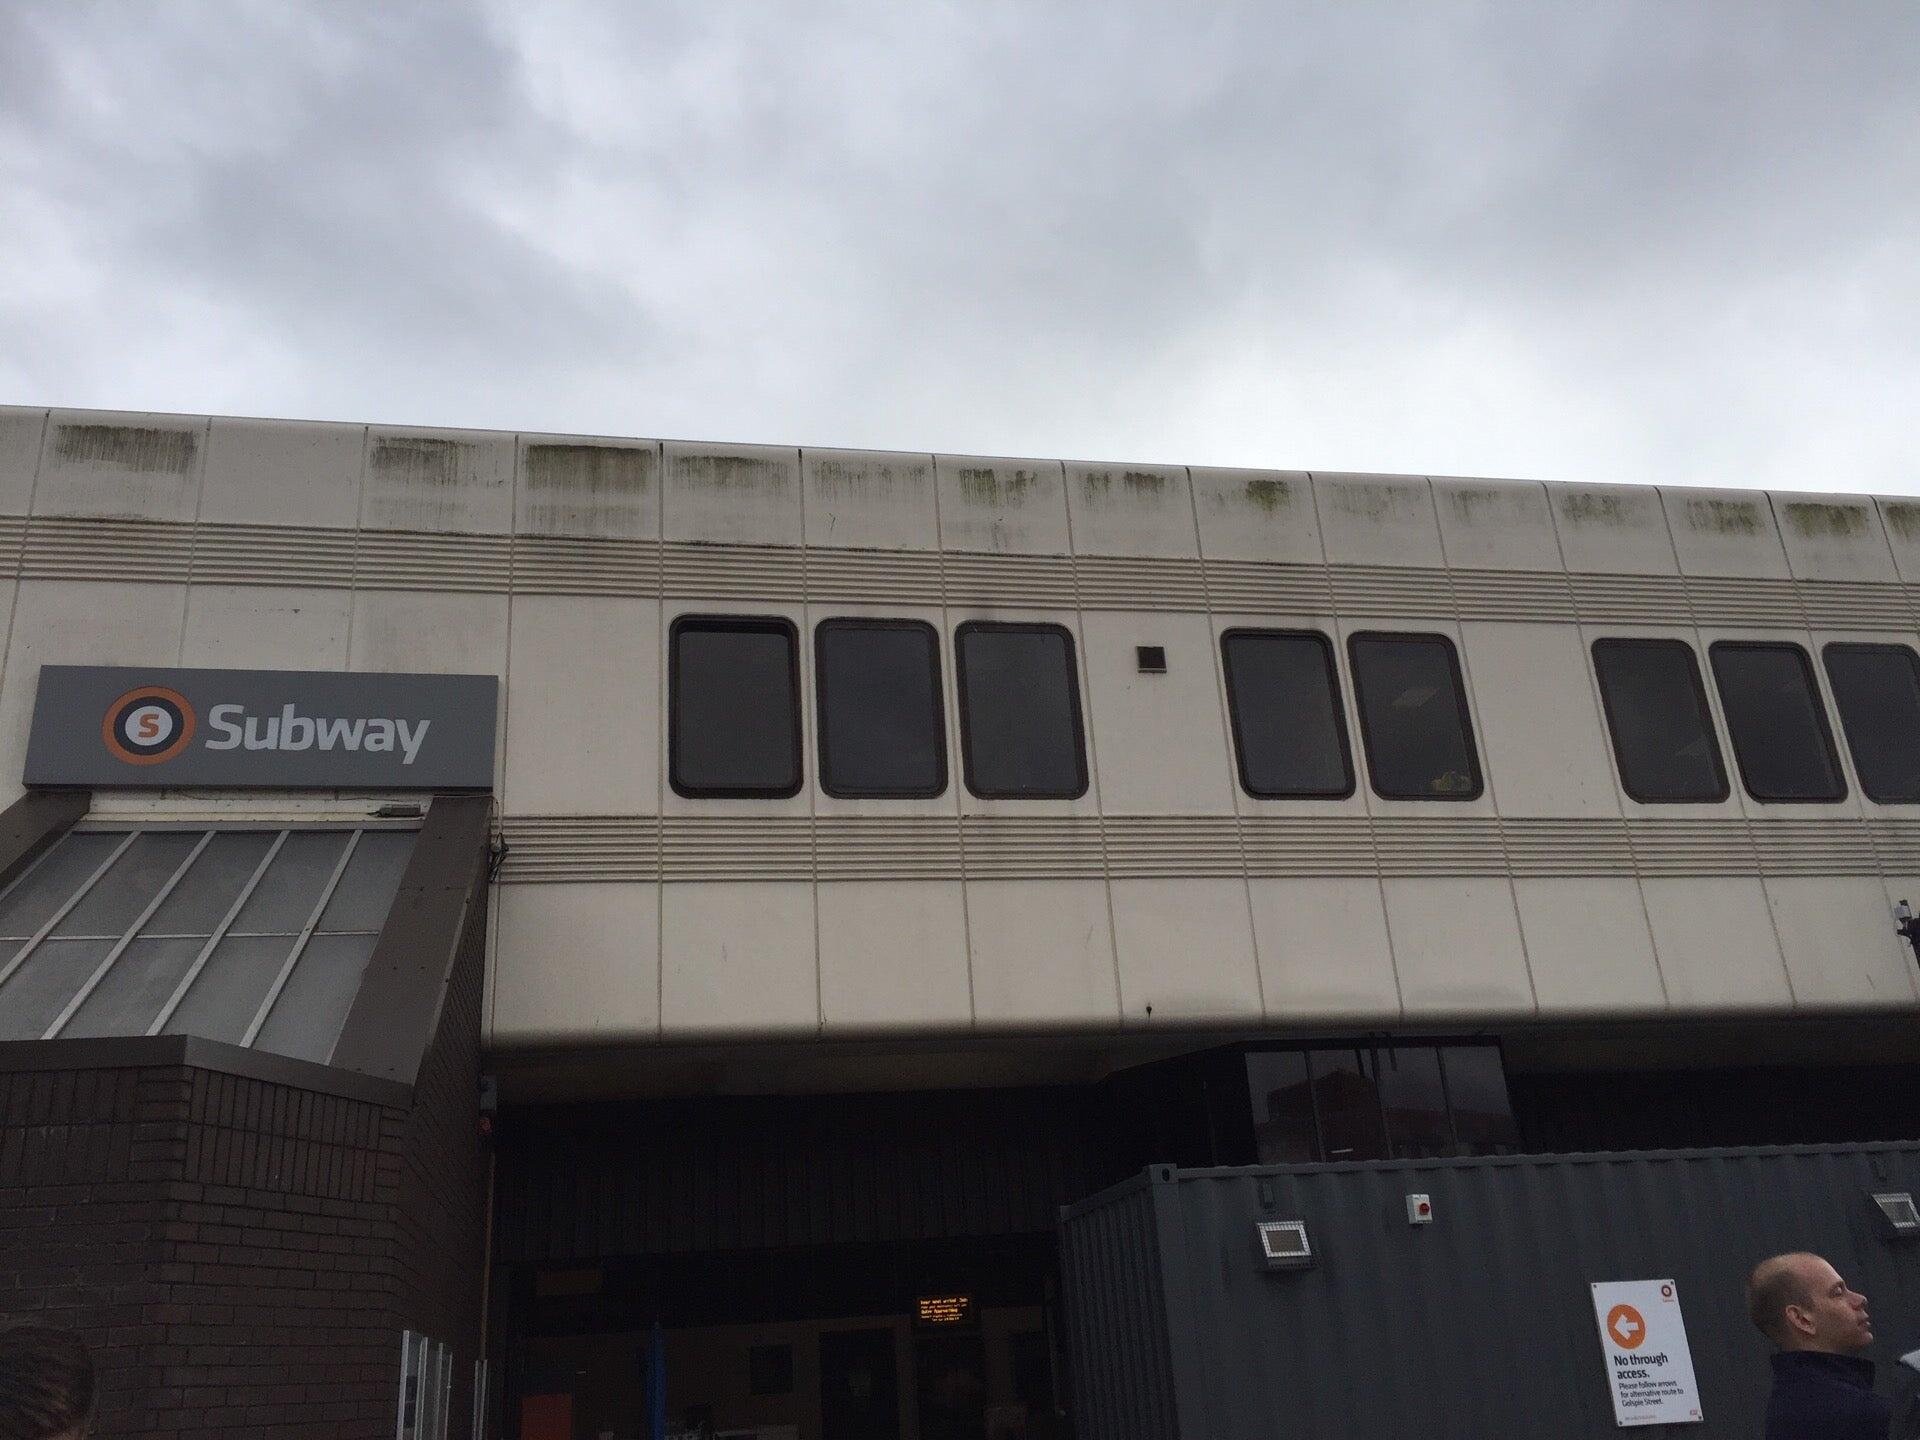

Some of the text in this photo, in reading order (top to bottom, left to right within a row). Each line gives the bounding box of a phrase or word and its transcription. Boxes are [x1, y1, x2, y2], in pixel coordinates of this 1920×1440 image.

[205, 702, 431, 765] Subway
[1614, 1352, 1668, 1367] No through
[1617, 1370, 1650, 1380] access.
[1619, 1382, 1638, 1390] Please
[1638, 1381, 1657, 1389] follow
[1630, 1389, 1661, 1398] alternative
